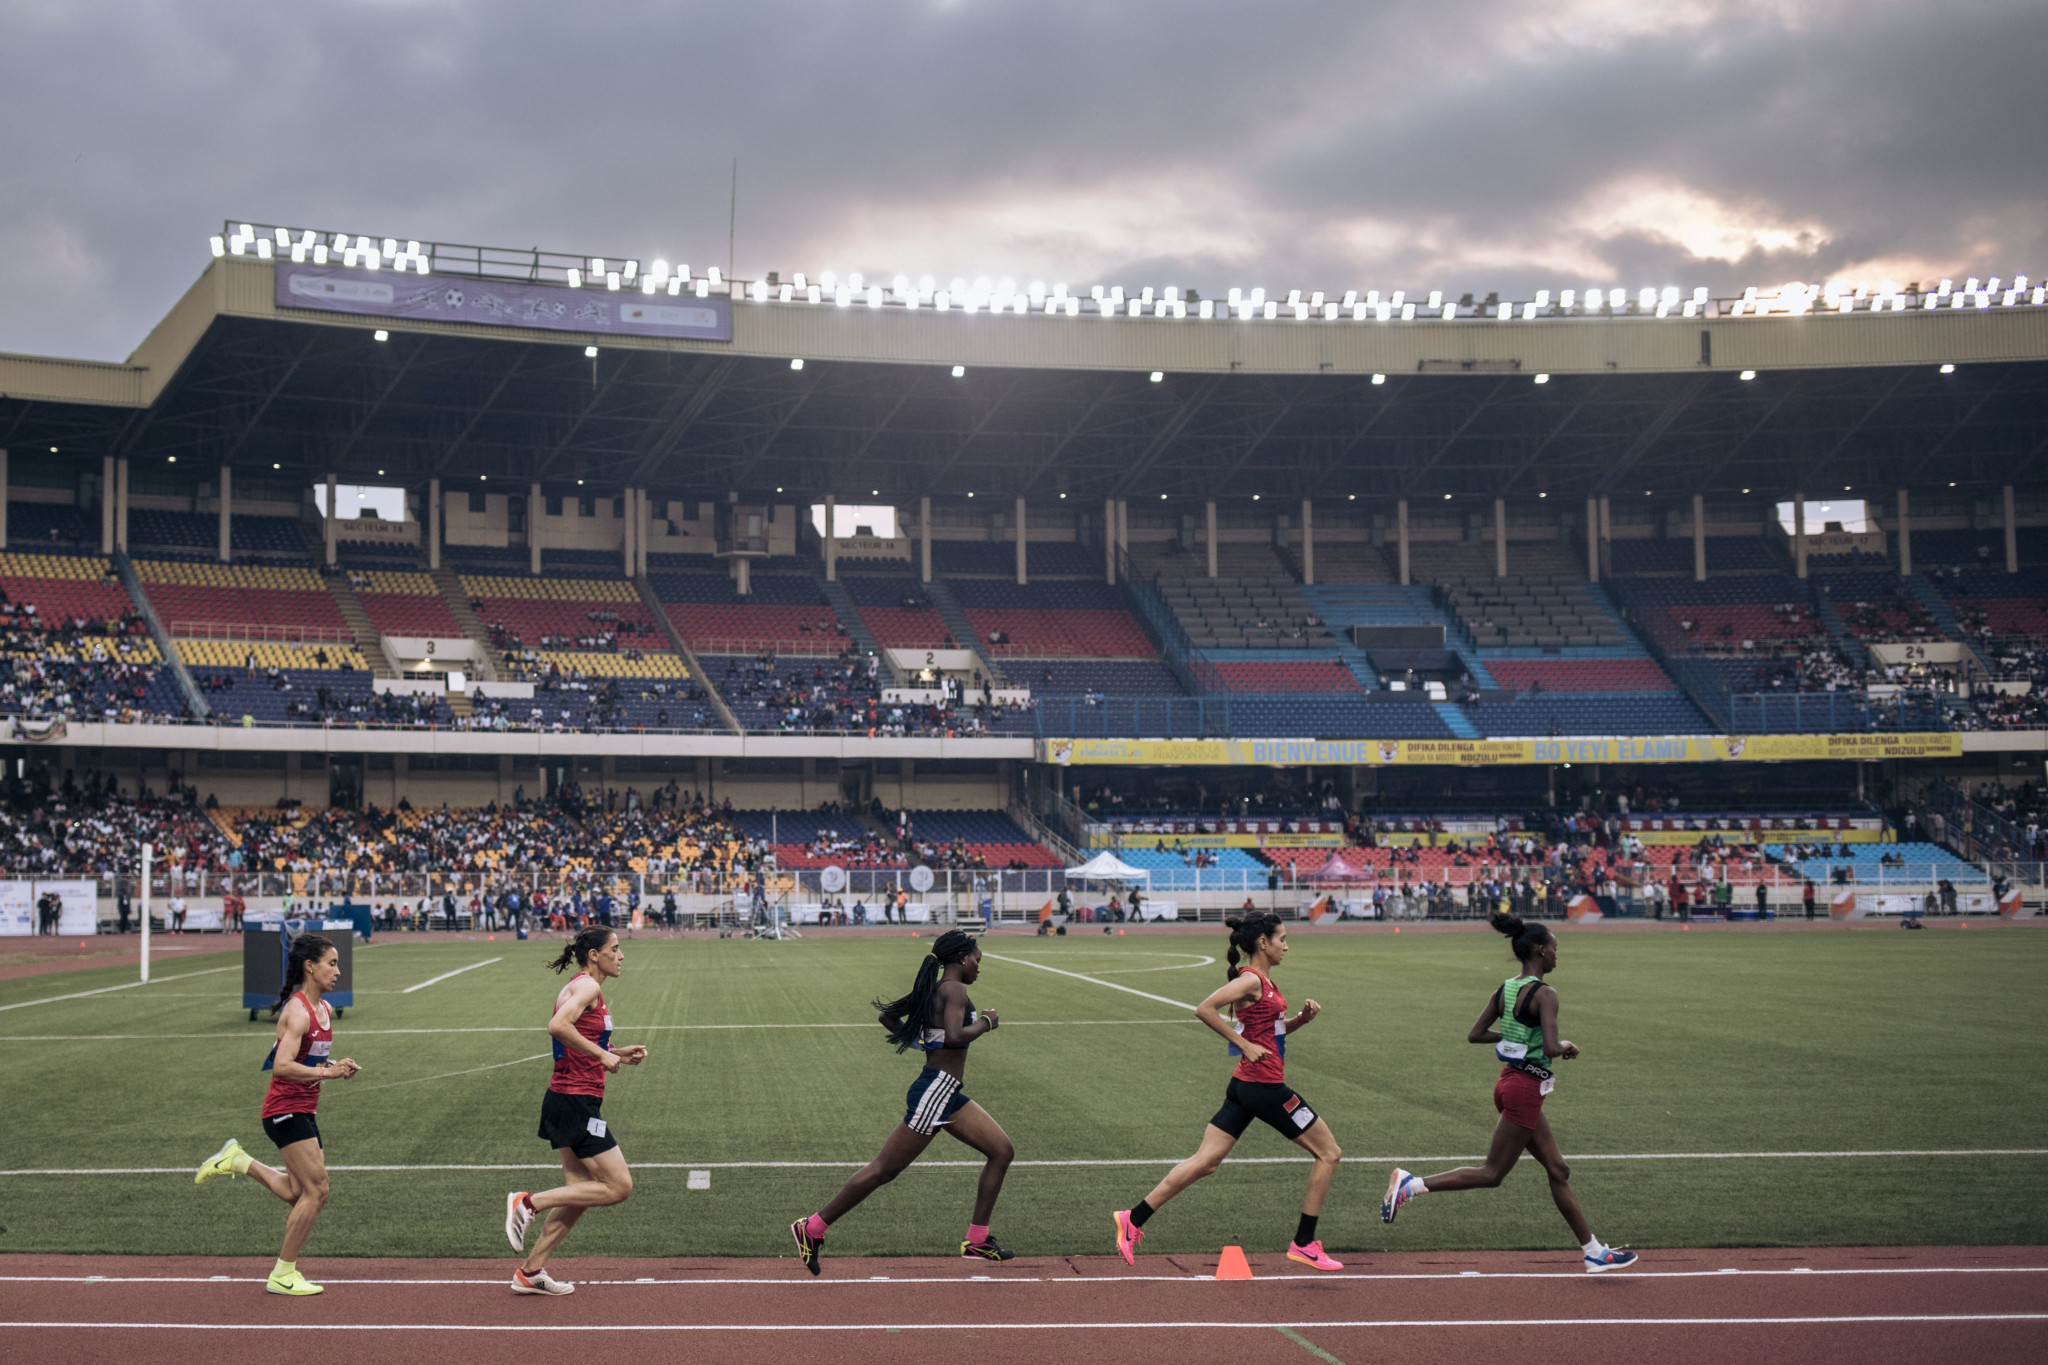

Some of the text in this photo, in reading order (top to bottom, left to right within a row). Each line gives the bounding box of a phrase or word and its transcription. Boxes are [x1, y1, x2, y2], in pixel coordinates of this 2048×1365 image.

[426, 641, 435, 654] 3
[1906, 645, 1925, 659] 24
[926, 651, 934, 665] 2
[1407, 743, 1436, 752] DIFIKA
[1438, 743, 1475, 752] DILENGA
[1828, 737, 1858, 746] DIFIKA
[1860, 736, 1899, 745] DILENGA
[1254, 742, 1368, 762] BIENVENUE
[1535, 740, 1686, 761] BO YEYI ELAMU
[1885, 746, 1925, 755] NDIZULU
[1460, 753, 1498, 762] NDIZULU
[1525, 1064, 1549, 1079] PRO
